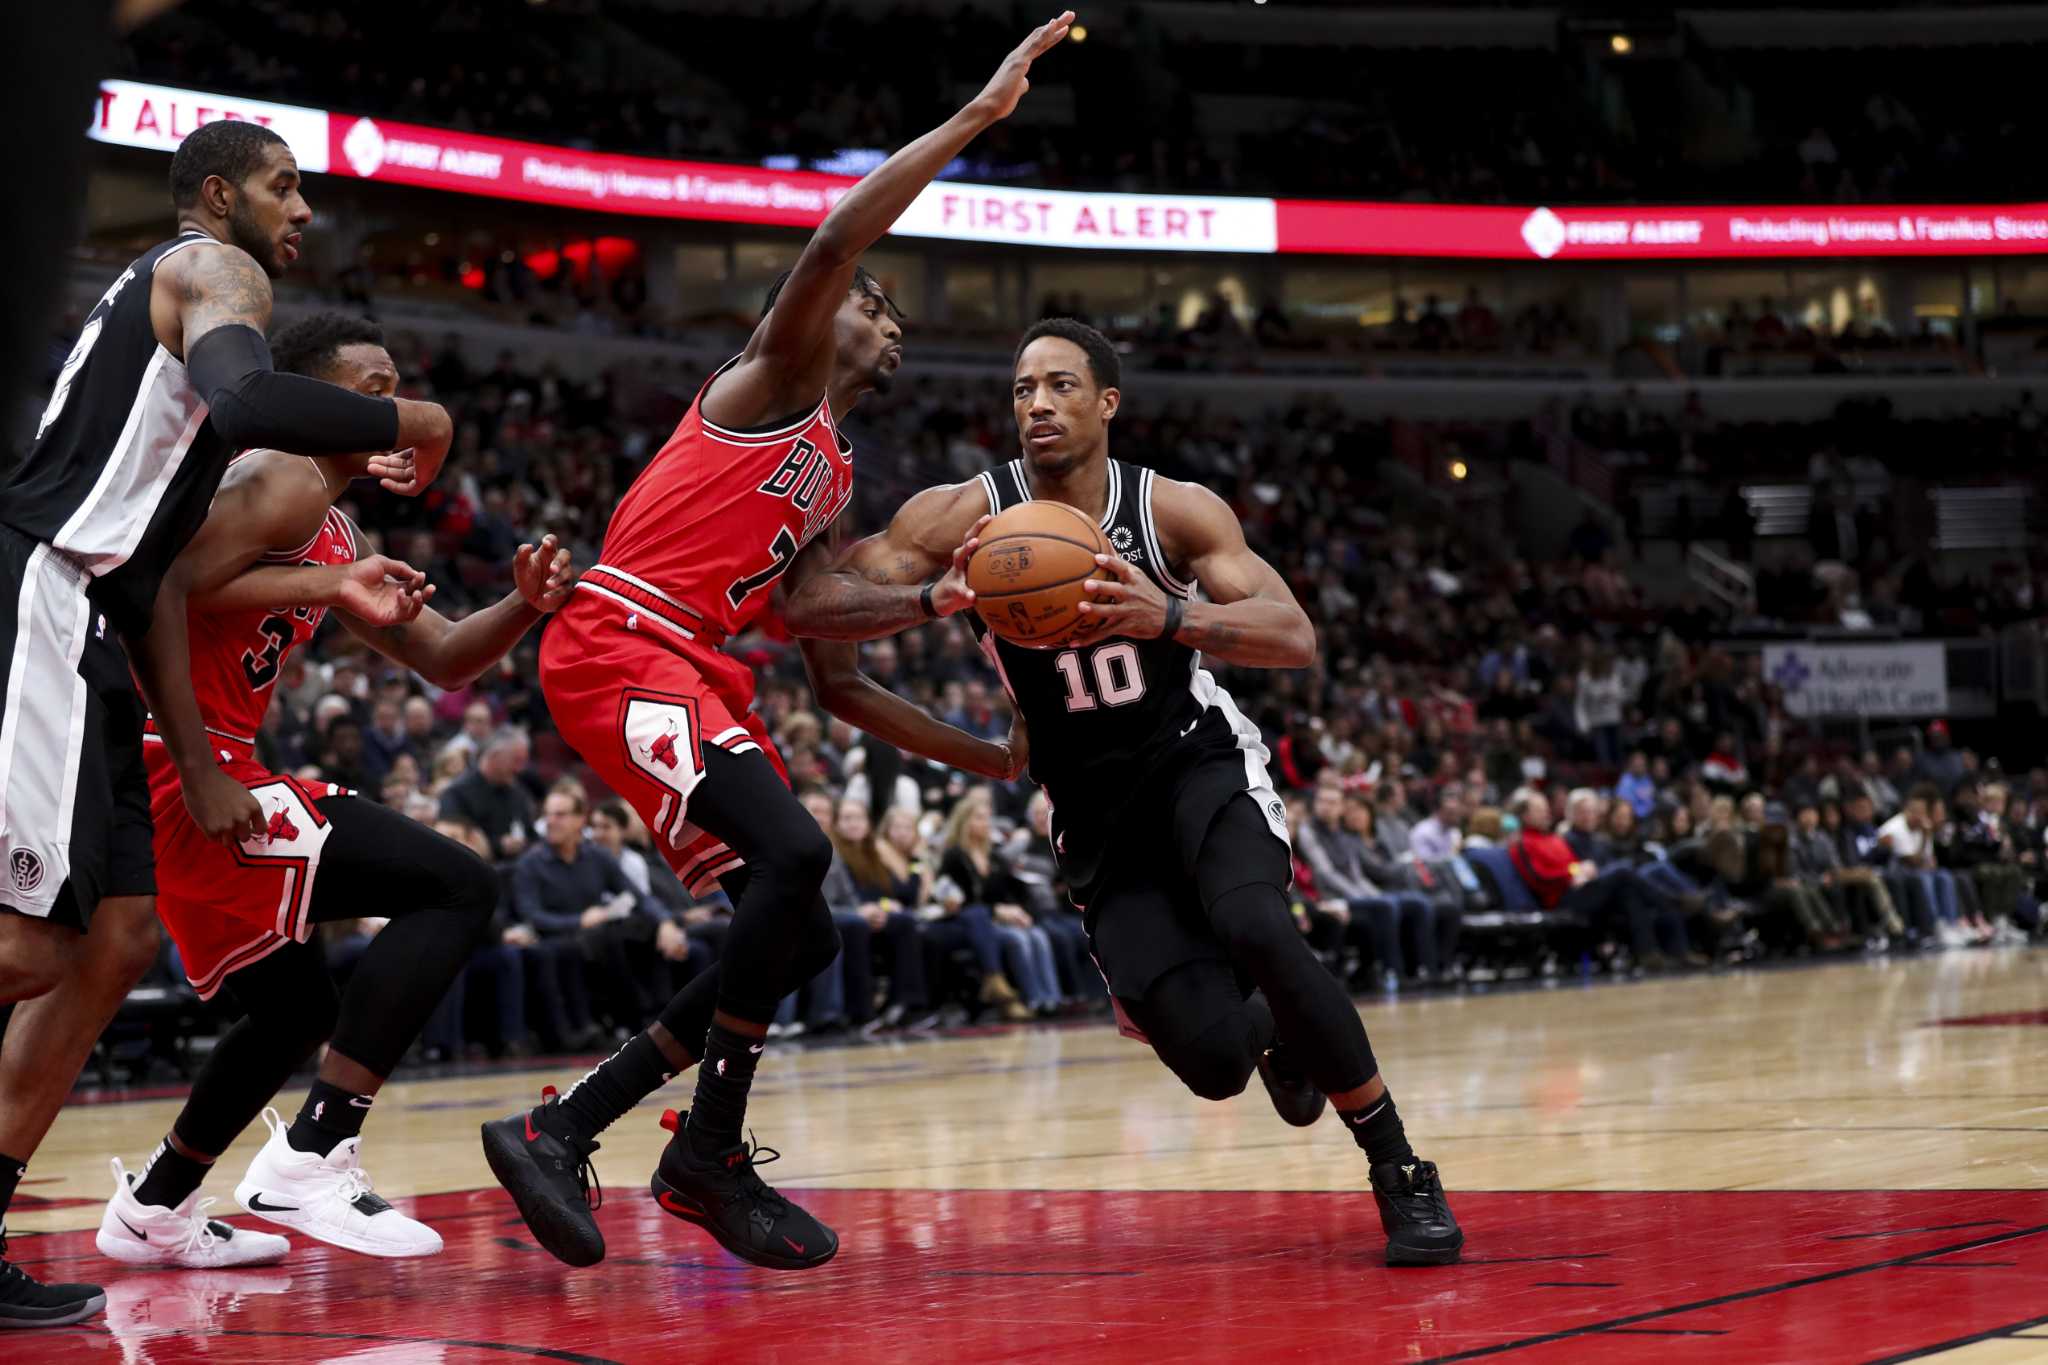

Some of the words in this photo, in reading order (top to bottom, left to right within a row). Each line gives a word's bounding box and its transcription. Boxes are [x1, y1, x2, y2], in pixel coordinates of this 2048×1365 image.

[941, 194, 1053, 233] FIRST
[1072, 205, 1218, 239] ALERT
[726, 523, 798, 611] 7
[1055, 642, 1146, 712] 10
